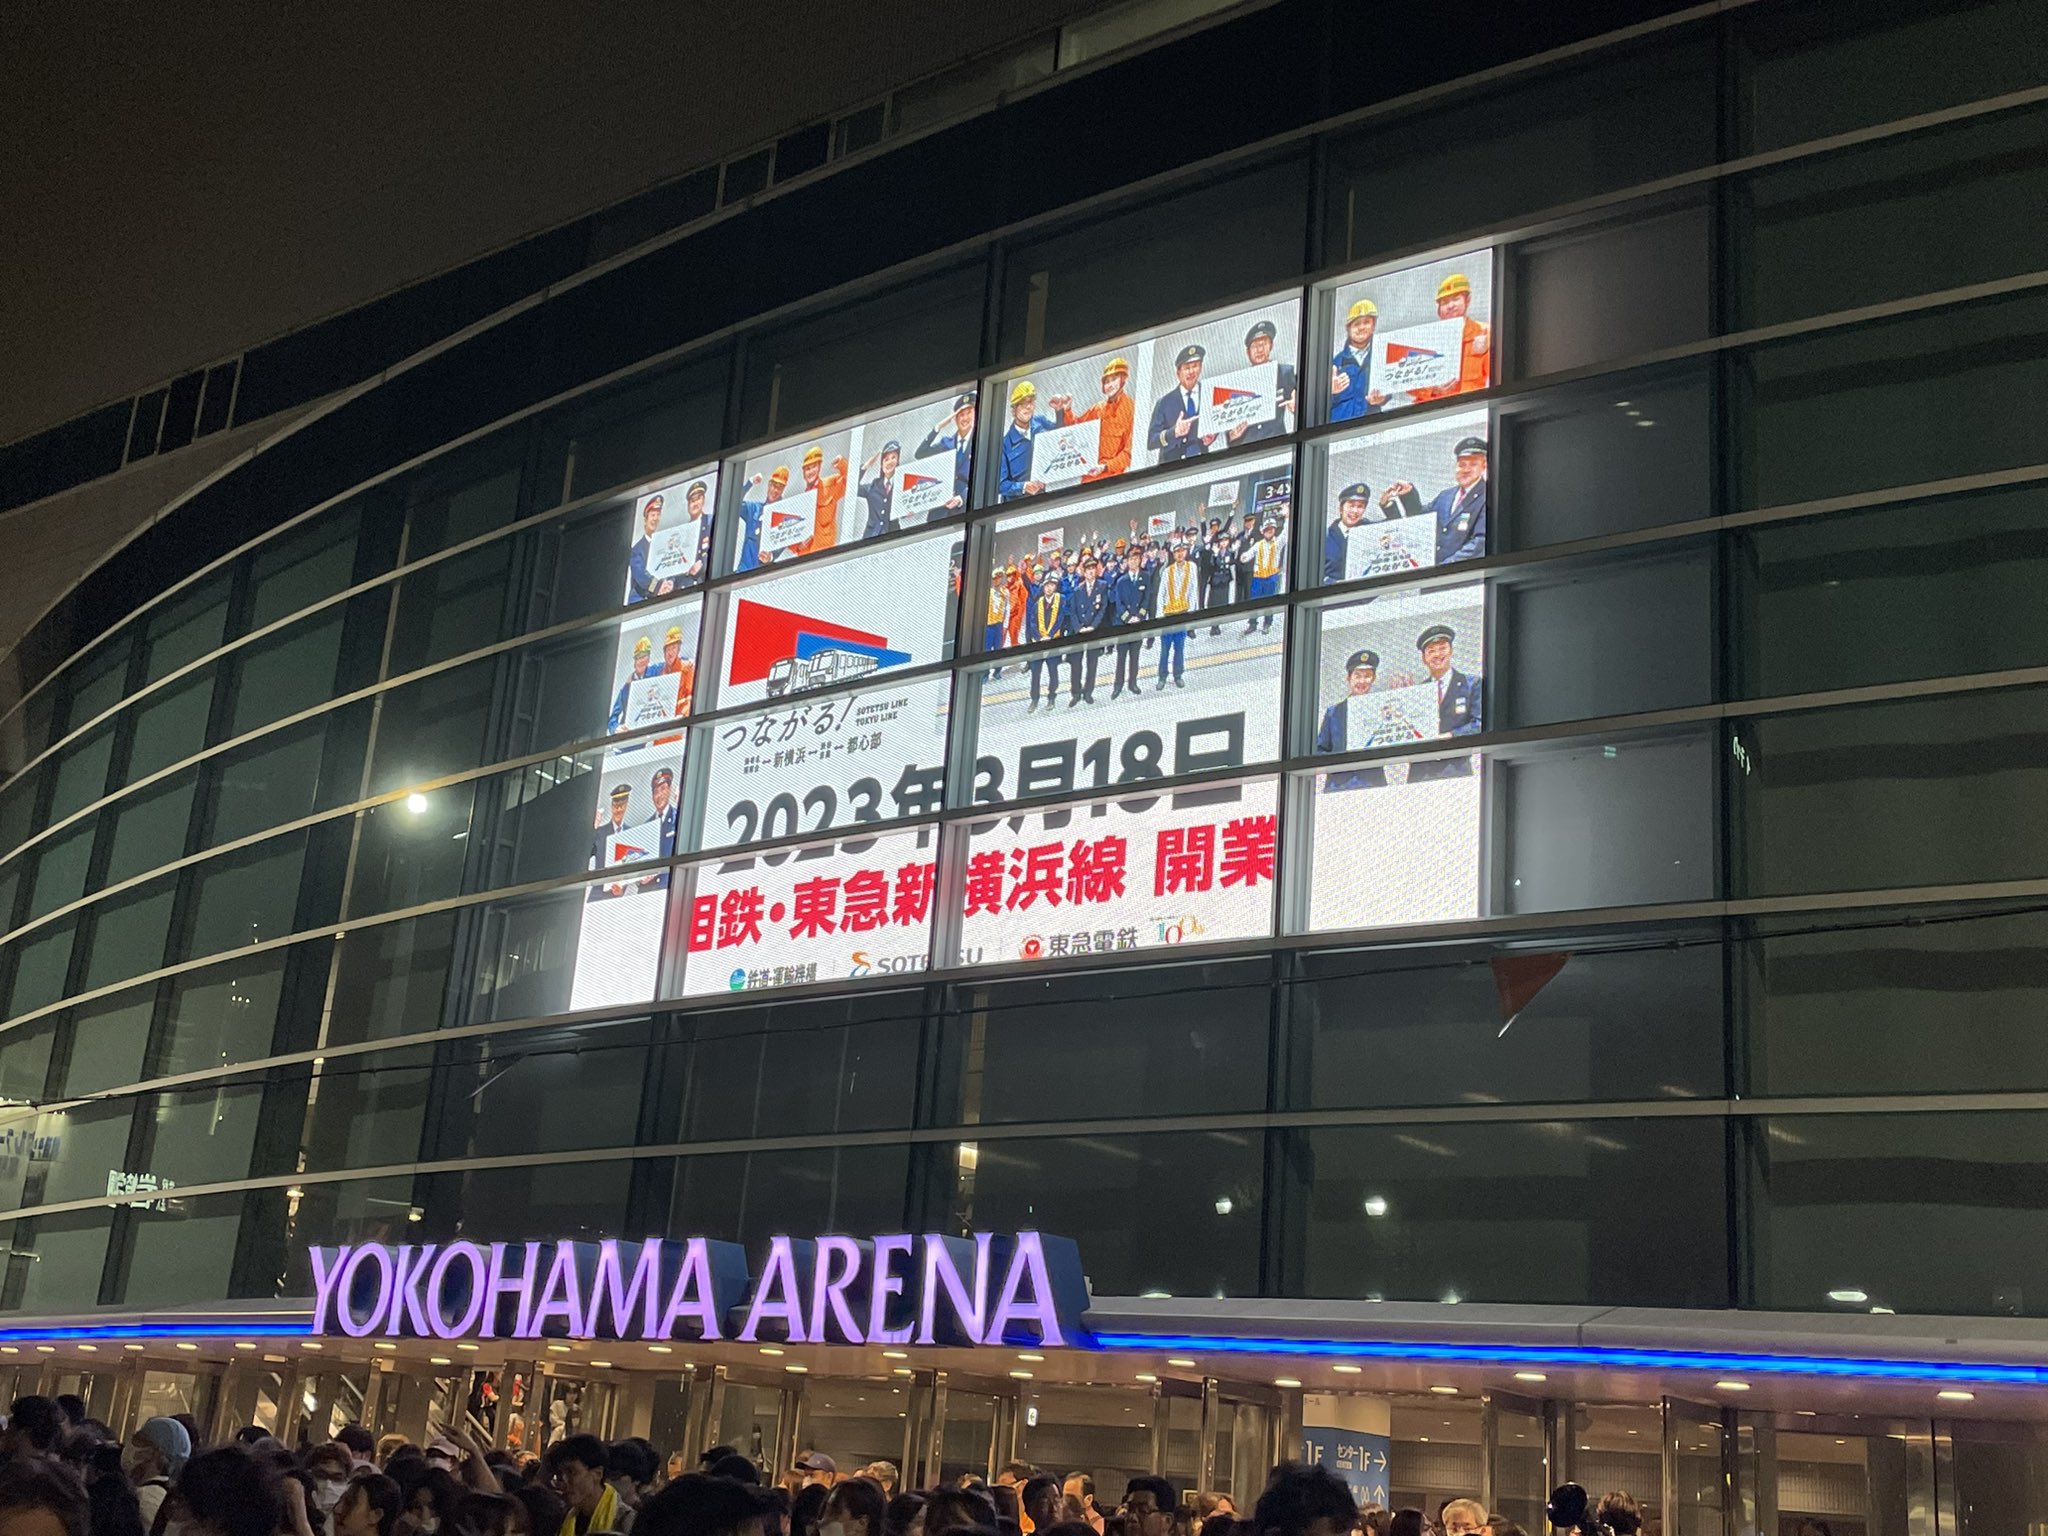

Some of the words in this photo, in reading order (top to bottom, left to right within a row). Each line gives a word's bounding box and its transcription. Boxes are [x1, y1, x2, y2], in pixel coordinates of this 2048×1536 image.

[722, 696, 858, 752] つながる!
[1153, 814, 1277, 898] 開業
[1048, 926, 1139, 957] 東急電鉄
[306, 1237, 720, 1340] YOKOHAMA
[735, 1231, 1068, 1347] ARENA
